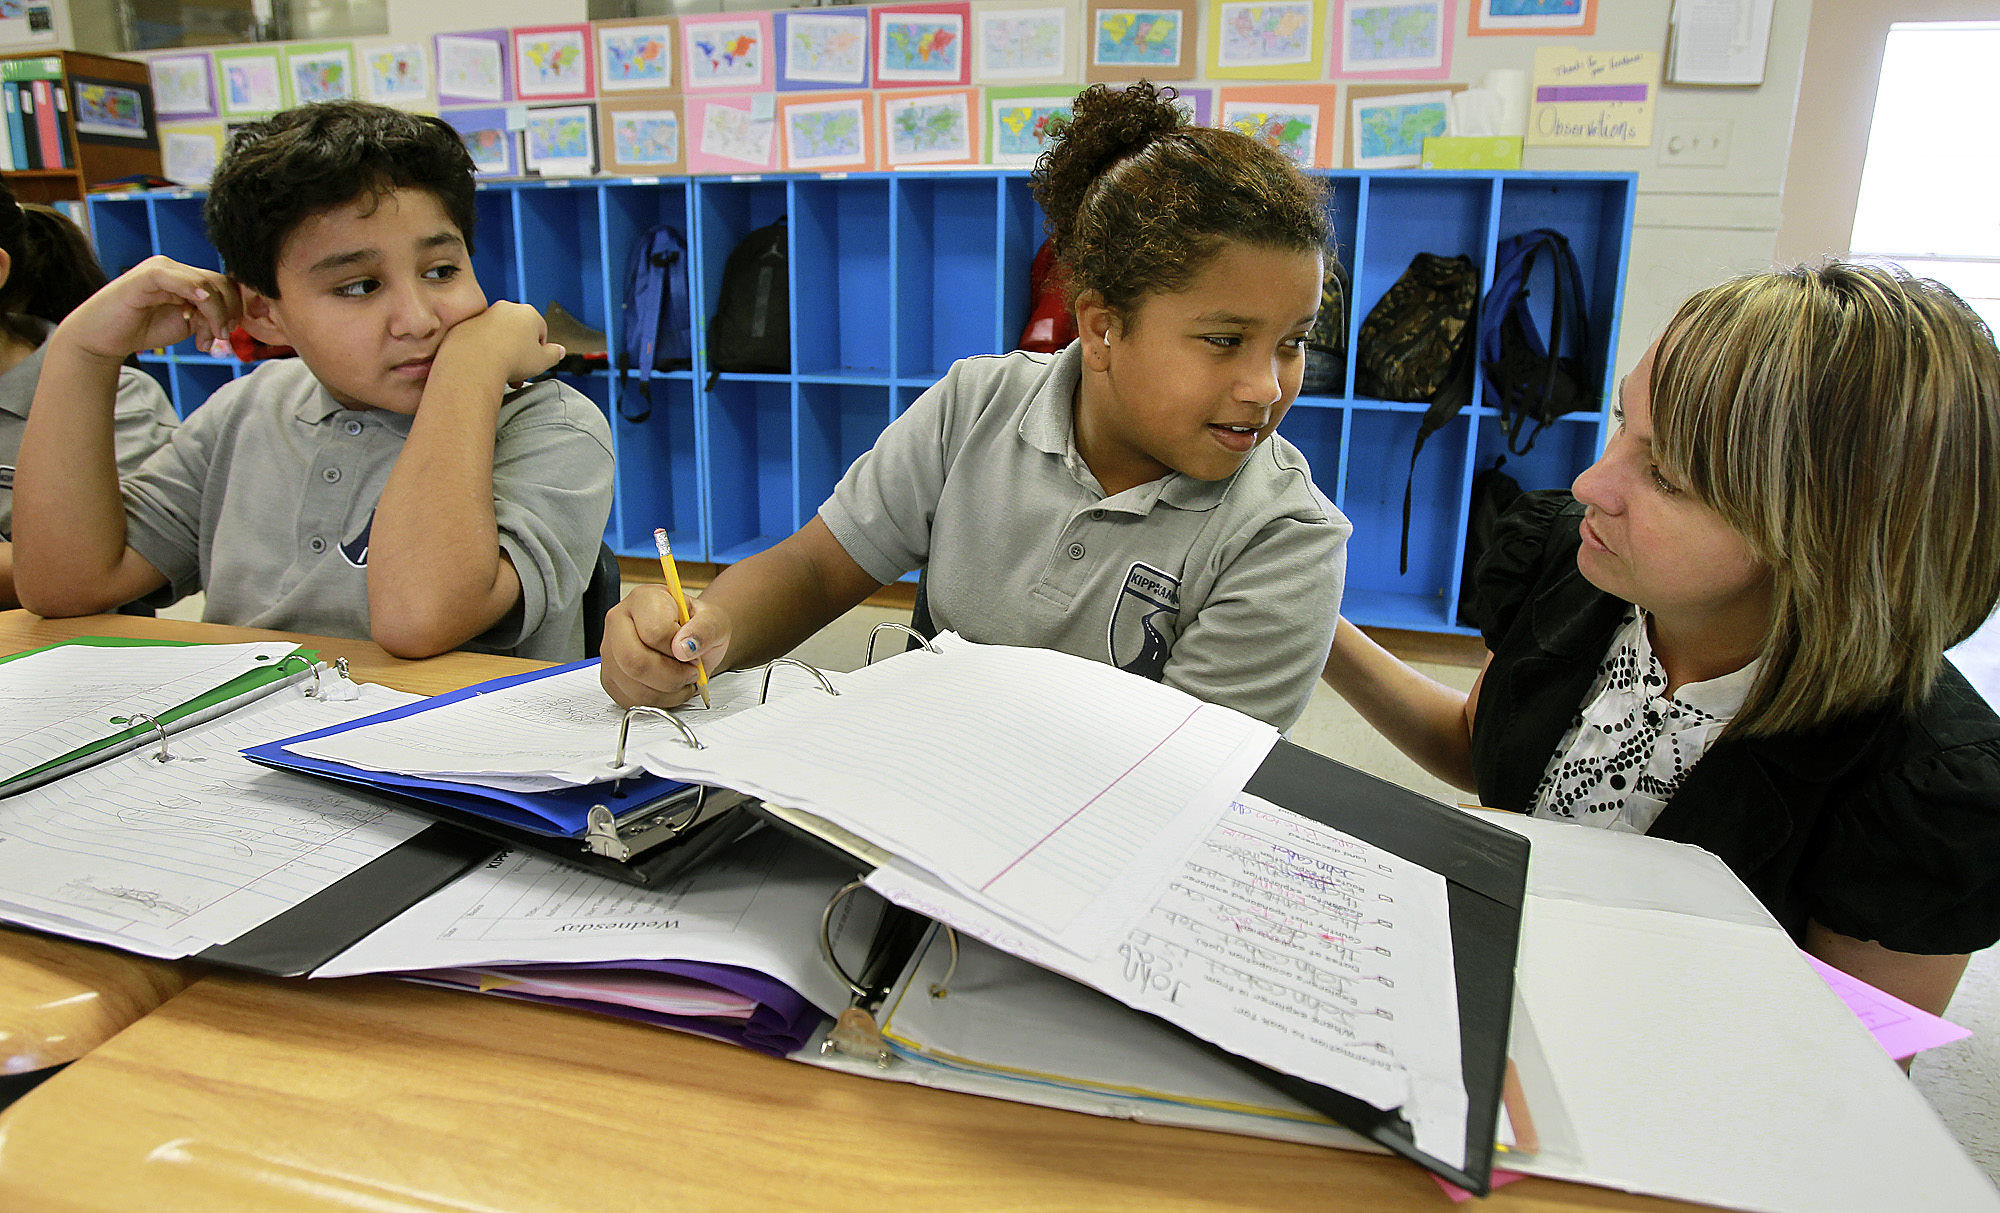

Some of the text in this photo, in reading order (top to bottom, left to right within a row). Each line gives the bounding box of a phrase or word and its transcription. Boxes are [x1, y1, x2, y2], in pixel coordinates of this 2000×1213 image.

[1538, 103, 1636, 141] Observations
[1288, 832, 1366, 862] Land discovered
[1183, 876, 1228, 893] explorer
[1243, 870, 1302, 894] exploration
[551, 919, 681, 934] Wednesday
[1291, 916, 1313, 926] that
[1318, 924, 1361, 944] Country
[1229, 952, 1292, 977] occupation
[1255, 996, 1307, 1019] explorer
[1312, 1017, 1355, 1038] Where
[1311, 1038, 1391, 1071] Information
